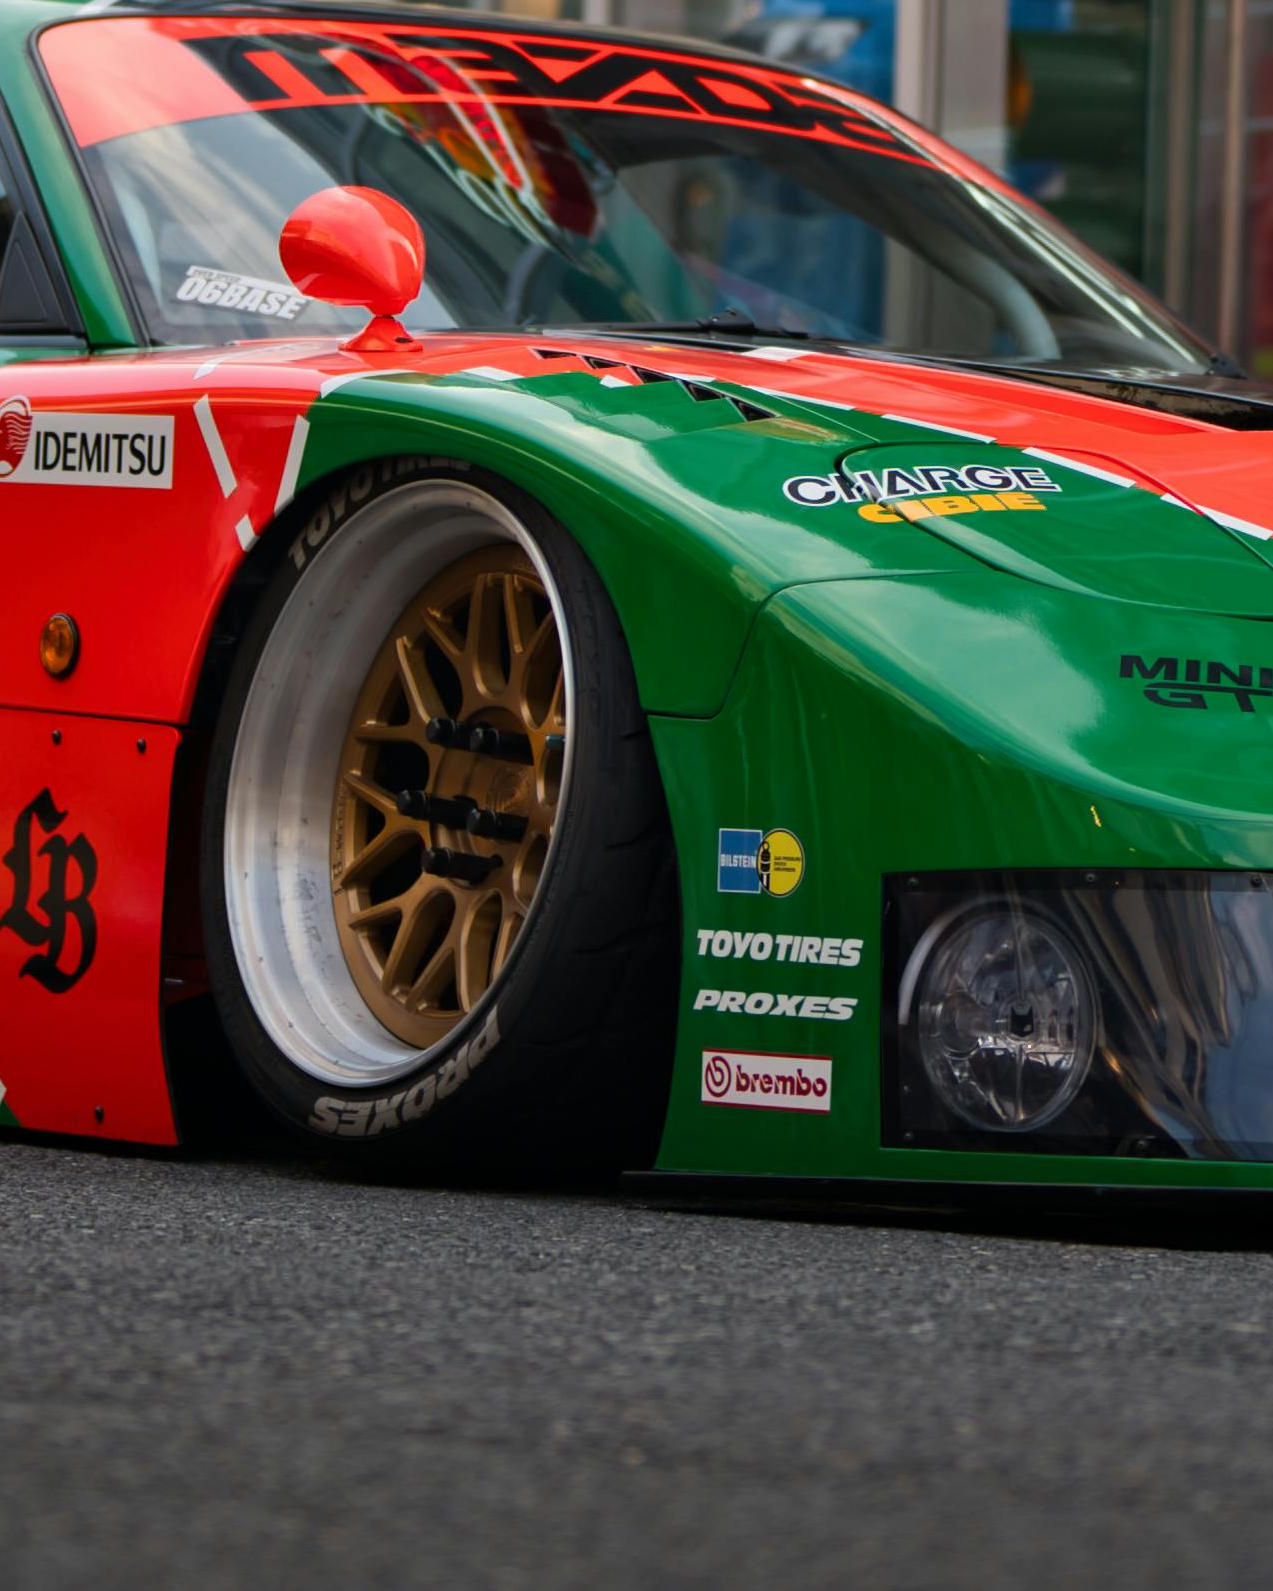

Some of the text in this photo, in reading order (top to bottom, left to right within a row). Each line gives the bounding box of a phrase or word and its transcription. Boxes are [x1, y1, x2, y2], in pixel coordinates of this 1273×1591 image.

[33, 430, 167, 477] IDEMITSU
[783, 463, 1063, 508] CHARGE
[857, 490, 1048, 525] CIBIE
[720, 853, 758, 869] BILSTEIN
[696, 928, 864, 967] TOYO TIRES
[692, 988, 859, 1021] PROXES
[306, 1003, 502, 1138] PROXES
[735, 1064, 828, 1098] brembo
